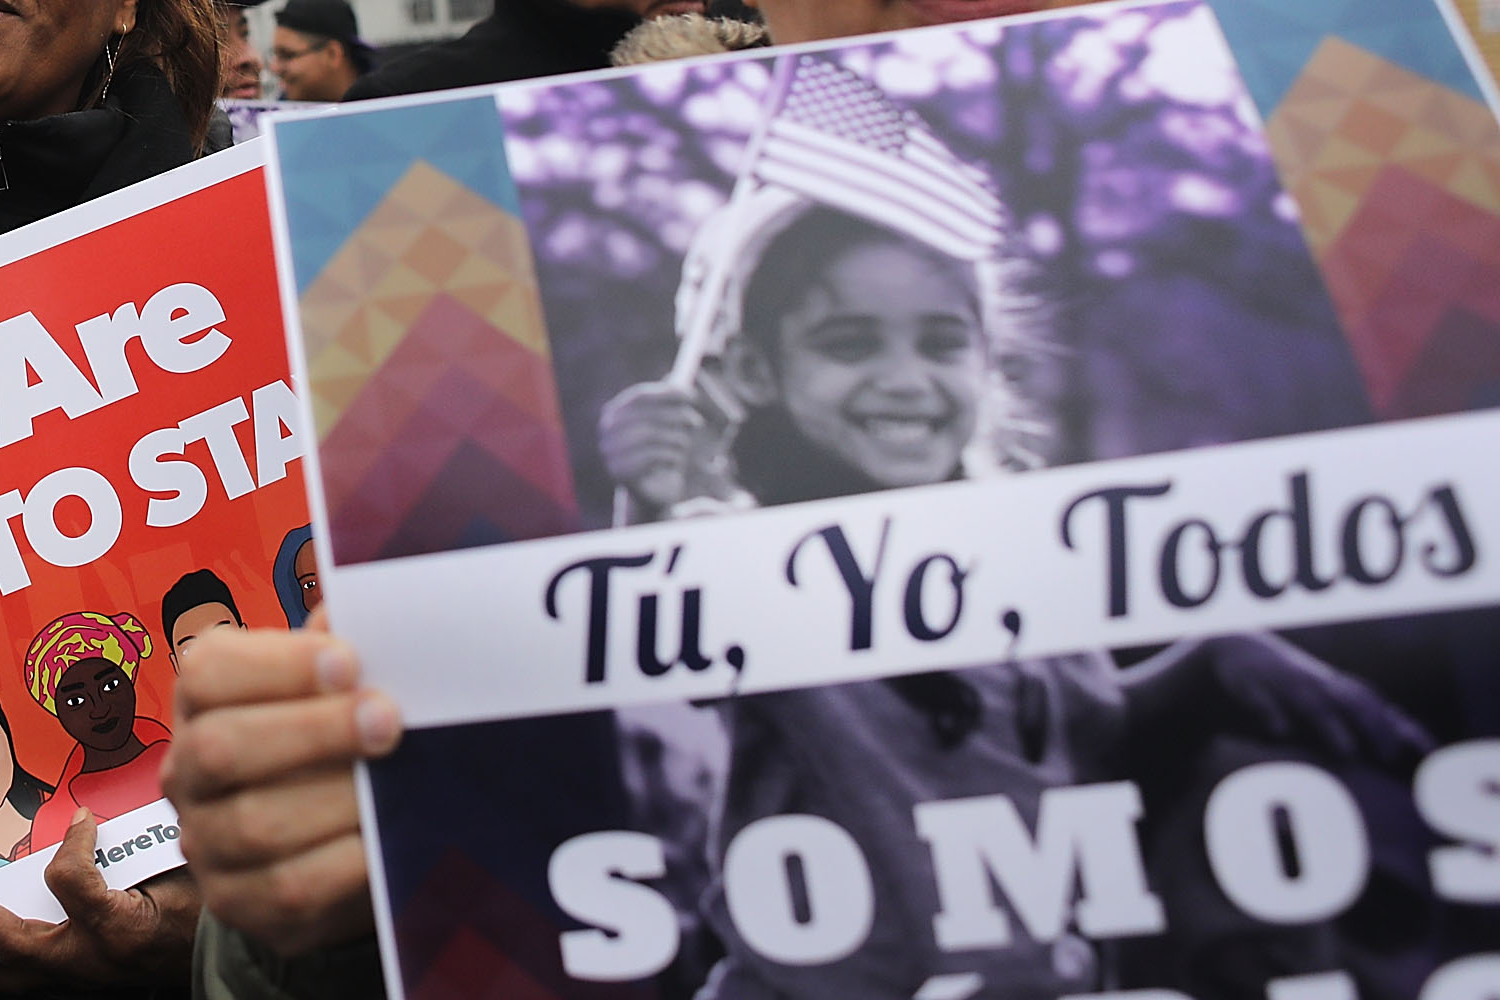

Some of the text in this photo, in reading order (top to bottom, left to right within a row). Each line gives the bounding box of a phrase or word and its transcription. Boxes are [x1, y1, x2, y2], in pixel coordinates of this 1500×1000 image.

[128, 373, 309, 528] STA
[545, 471, 1478, 698] Tú, Yo, Todos
[95, 823, 181, 869] HereTo
[547, 737, 1500, 984] SOMOS
